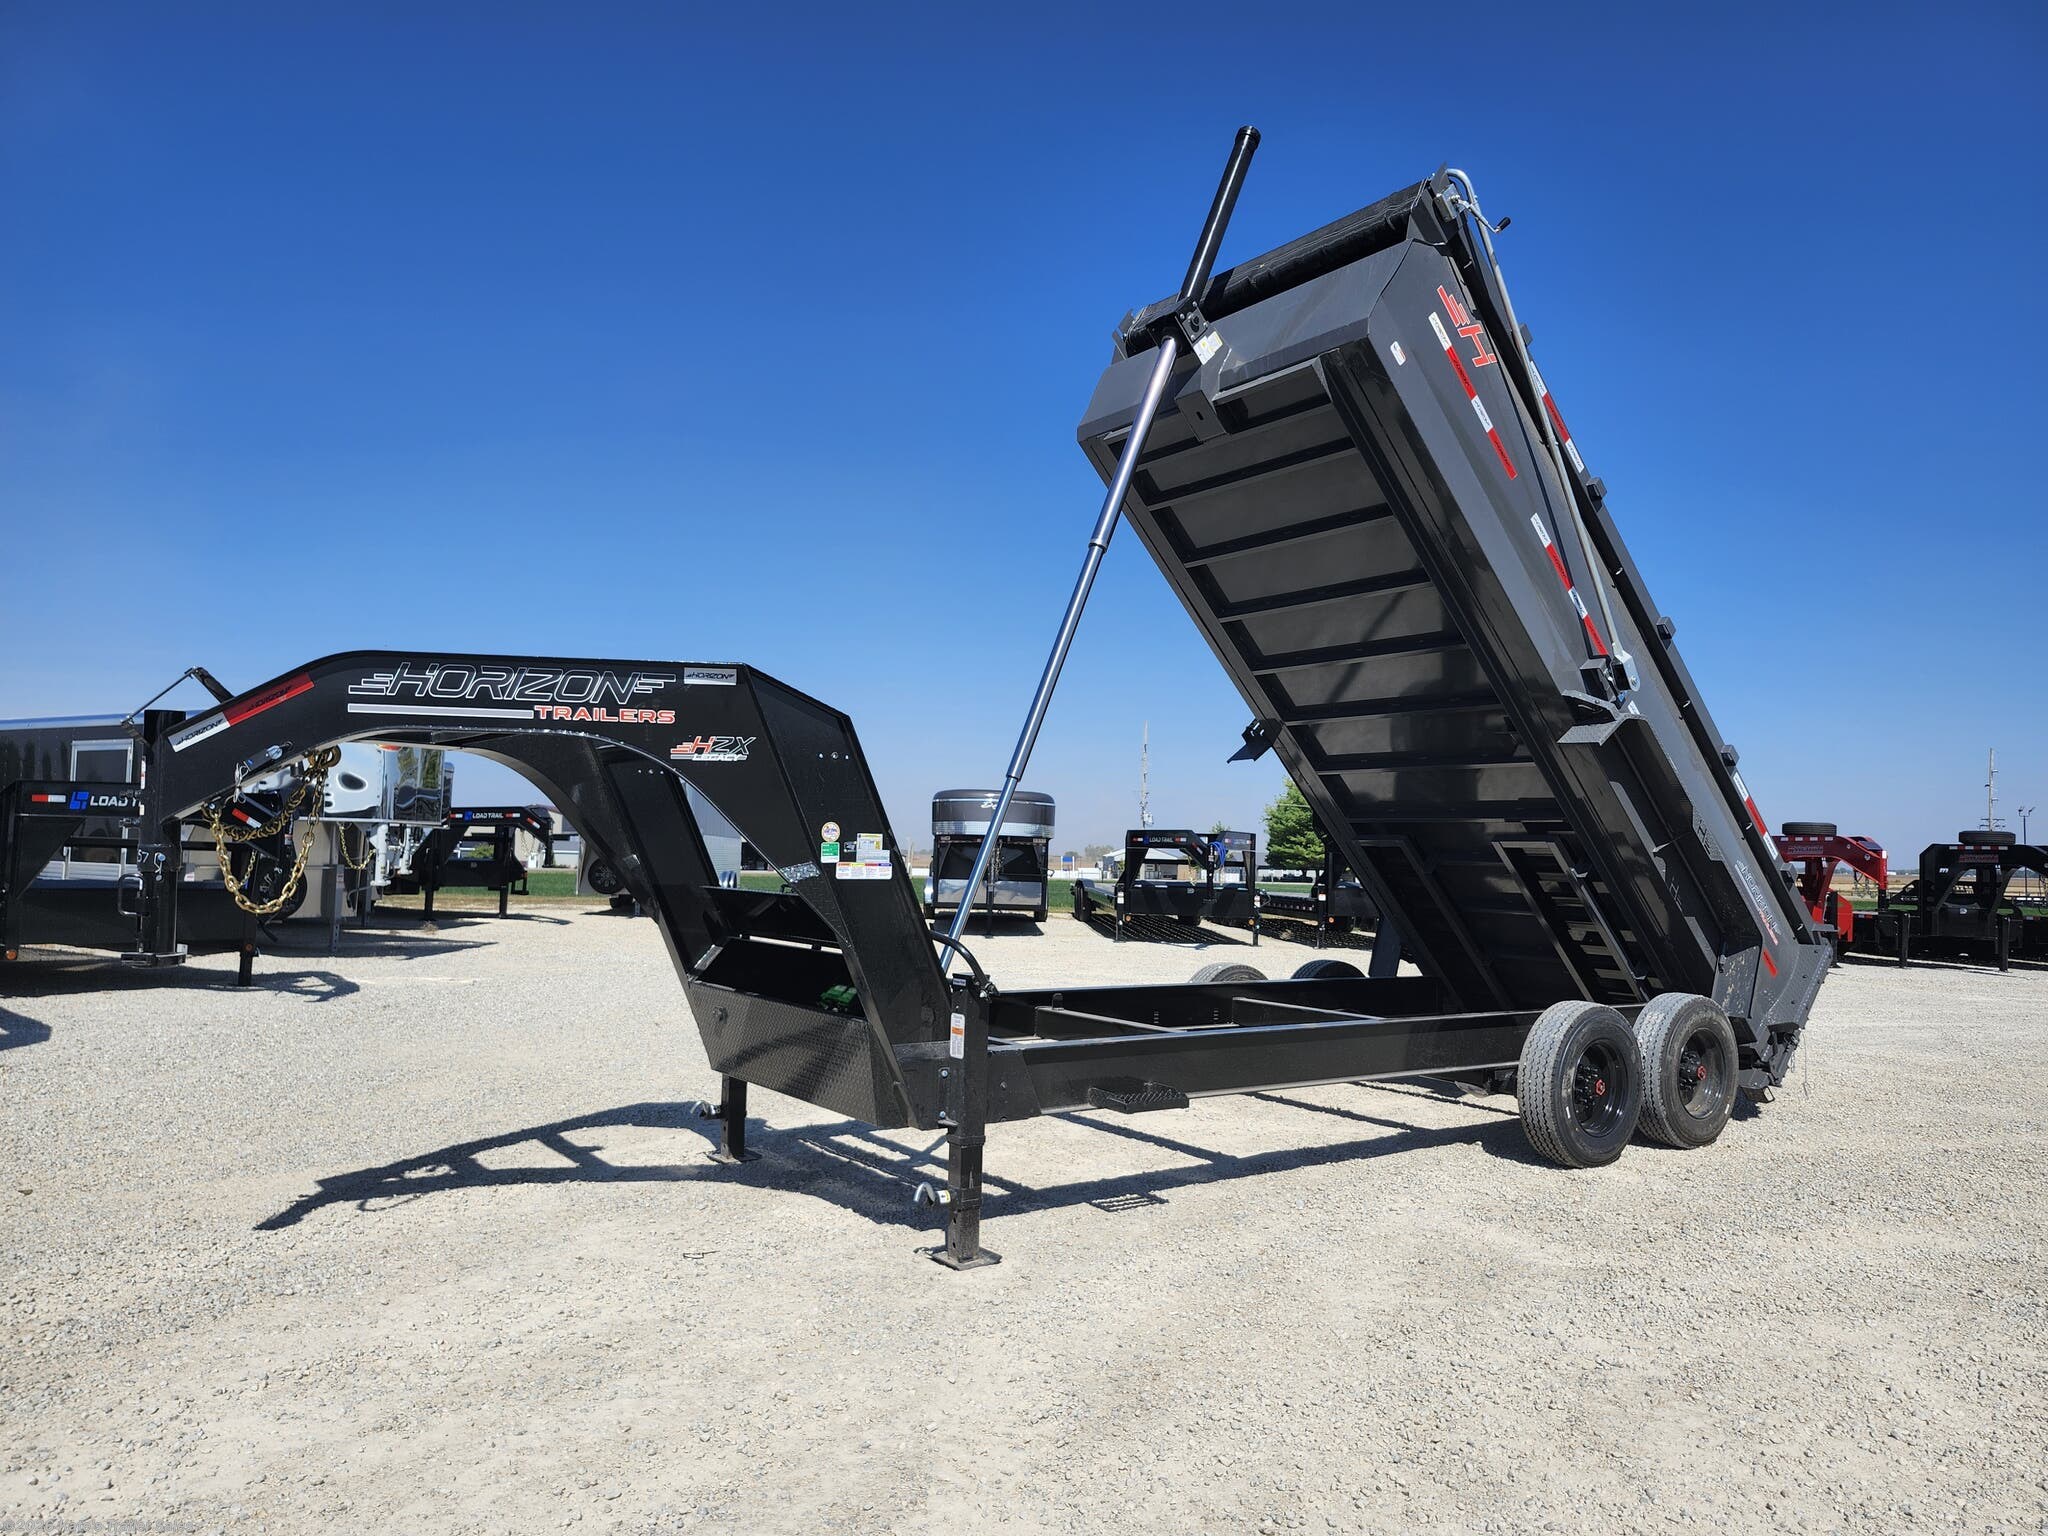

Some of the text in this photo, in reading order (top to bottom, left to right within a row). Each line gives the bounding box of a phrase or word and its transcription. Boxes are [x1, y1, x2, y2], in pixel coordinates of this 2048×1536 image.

[386, 661, 639, 705] HORIZON
[690, 671, 730, 680] HORIZON
[534, 704, 676, 724] TRAILERS
[179, 720, 221, 743] HORIZON
[690, 735, 756, 755] HZX
[692, 753, 740, 762] LEGACY
[90, 795, 129, 807] LOAD
